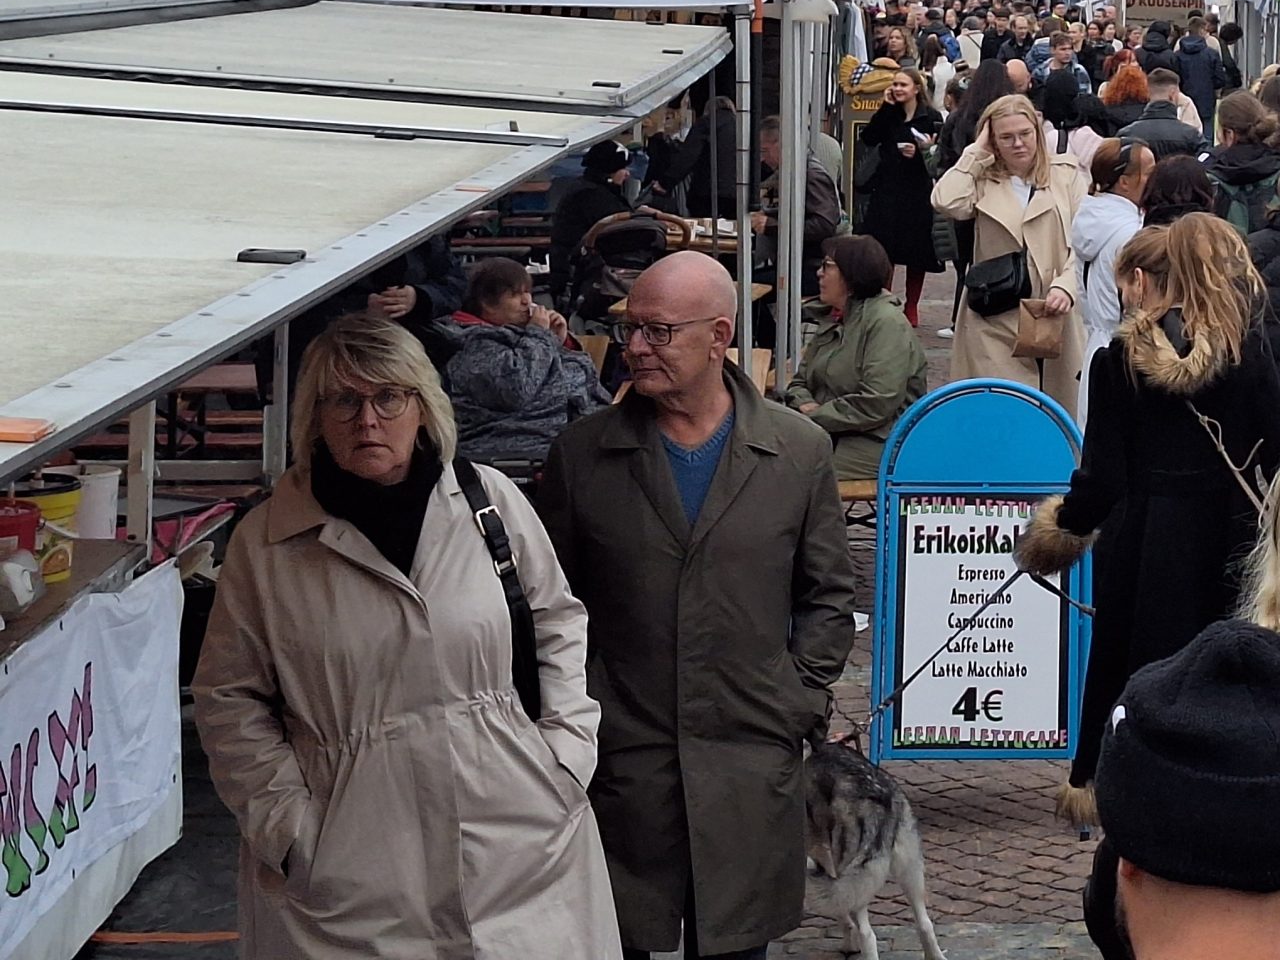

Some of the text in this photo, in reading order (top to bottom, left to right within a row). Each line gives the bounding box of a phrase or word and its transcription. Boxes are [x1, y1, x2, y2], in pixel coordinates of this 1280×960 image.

[851, 95, 884, 111] Snac
[900, 496, 966, 516] LEENAN
[913, 525, 1020, 555] ErikoisKa
[958, 563, 1006, 582] Espresso
[947, 612, 1014, 630] Cappuccino
[946, 636, 1014, 653] Caffe Latte
[932, 660, 1028, 678] Latte Macchiato
[951, 686, 1004, 722] 4€
[893, 726, 1069, 749] LEENAN LETTUCAFE
